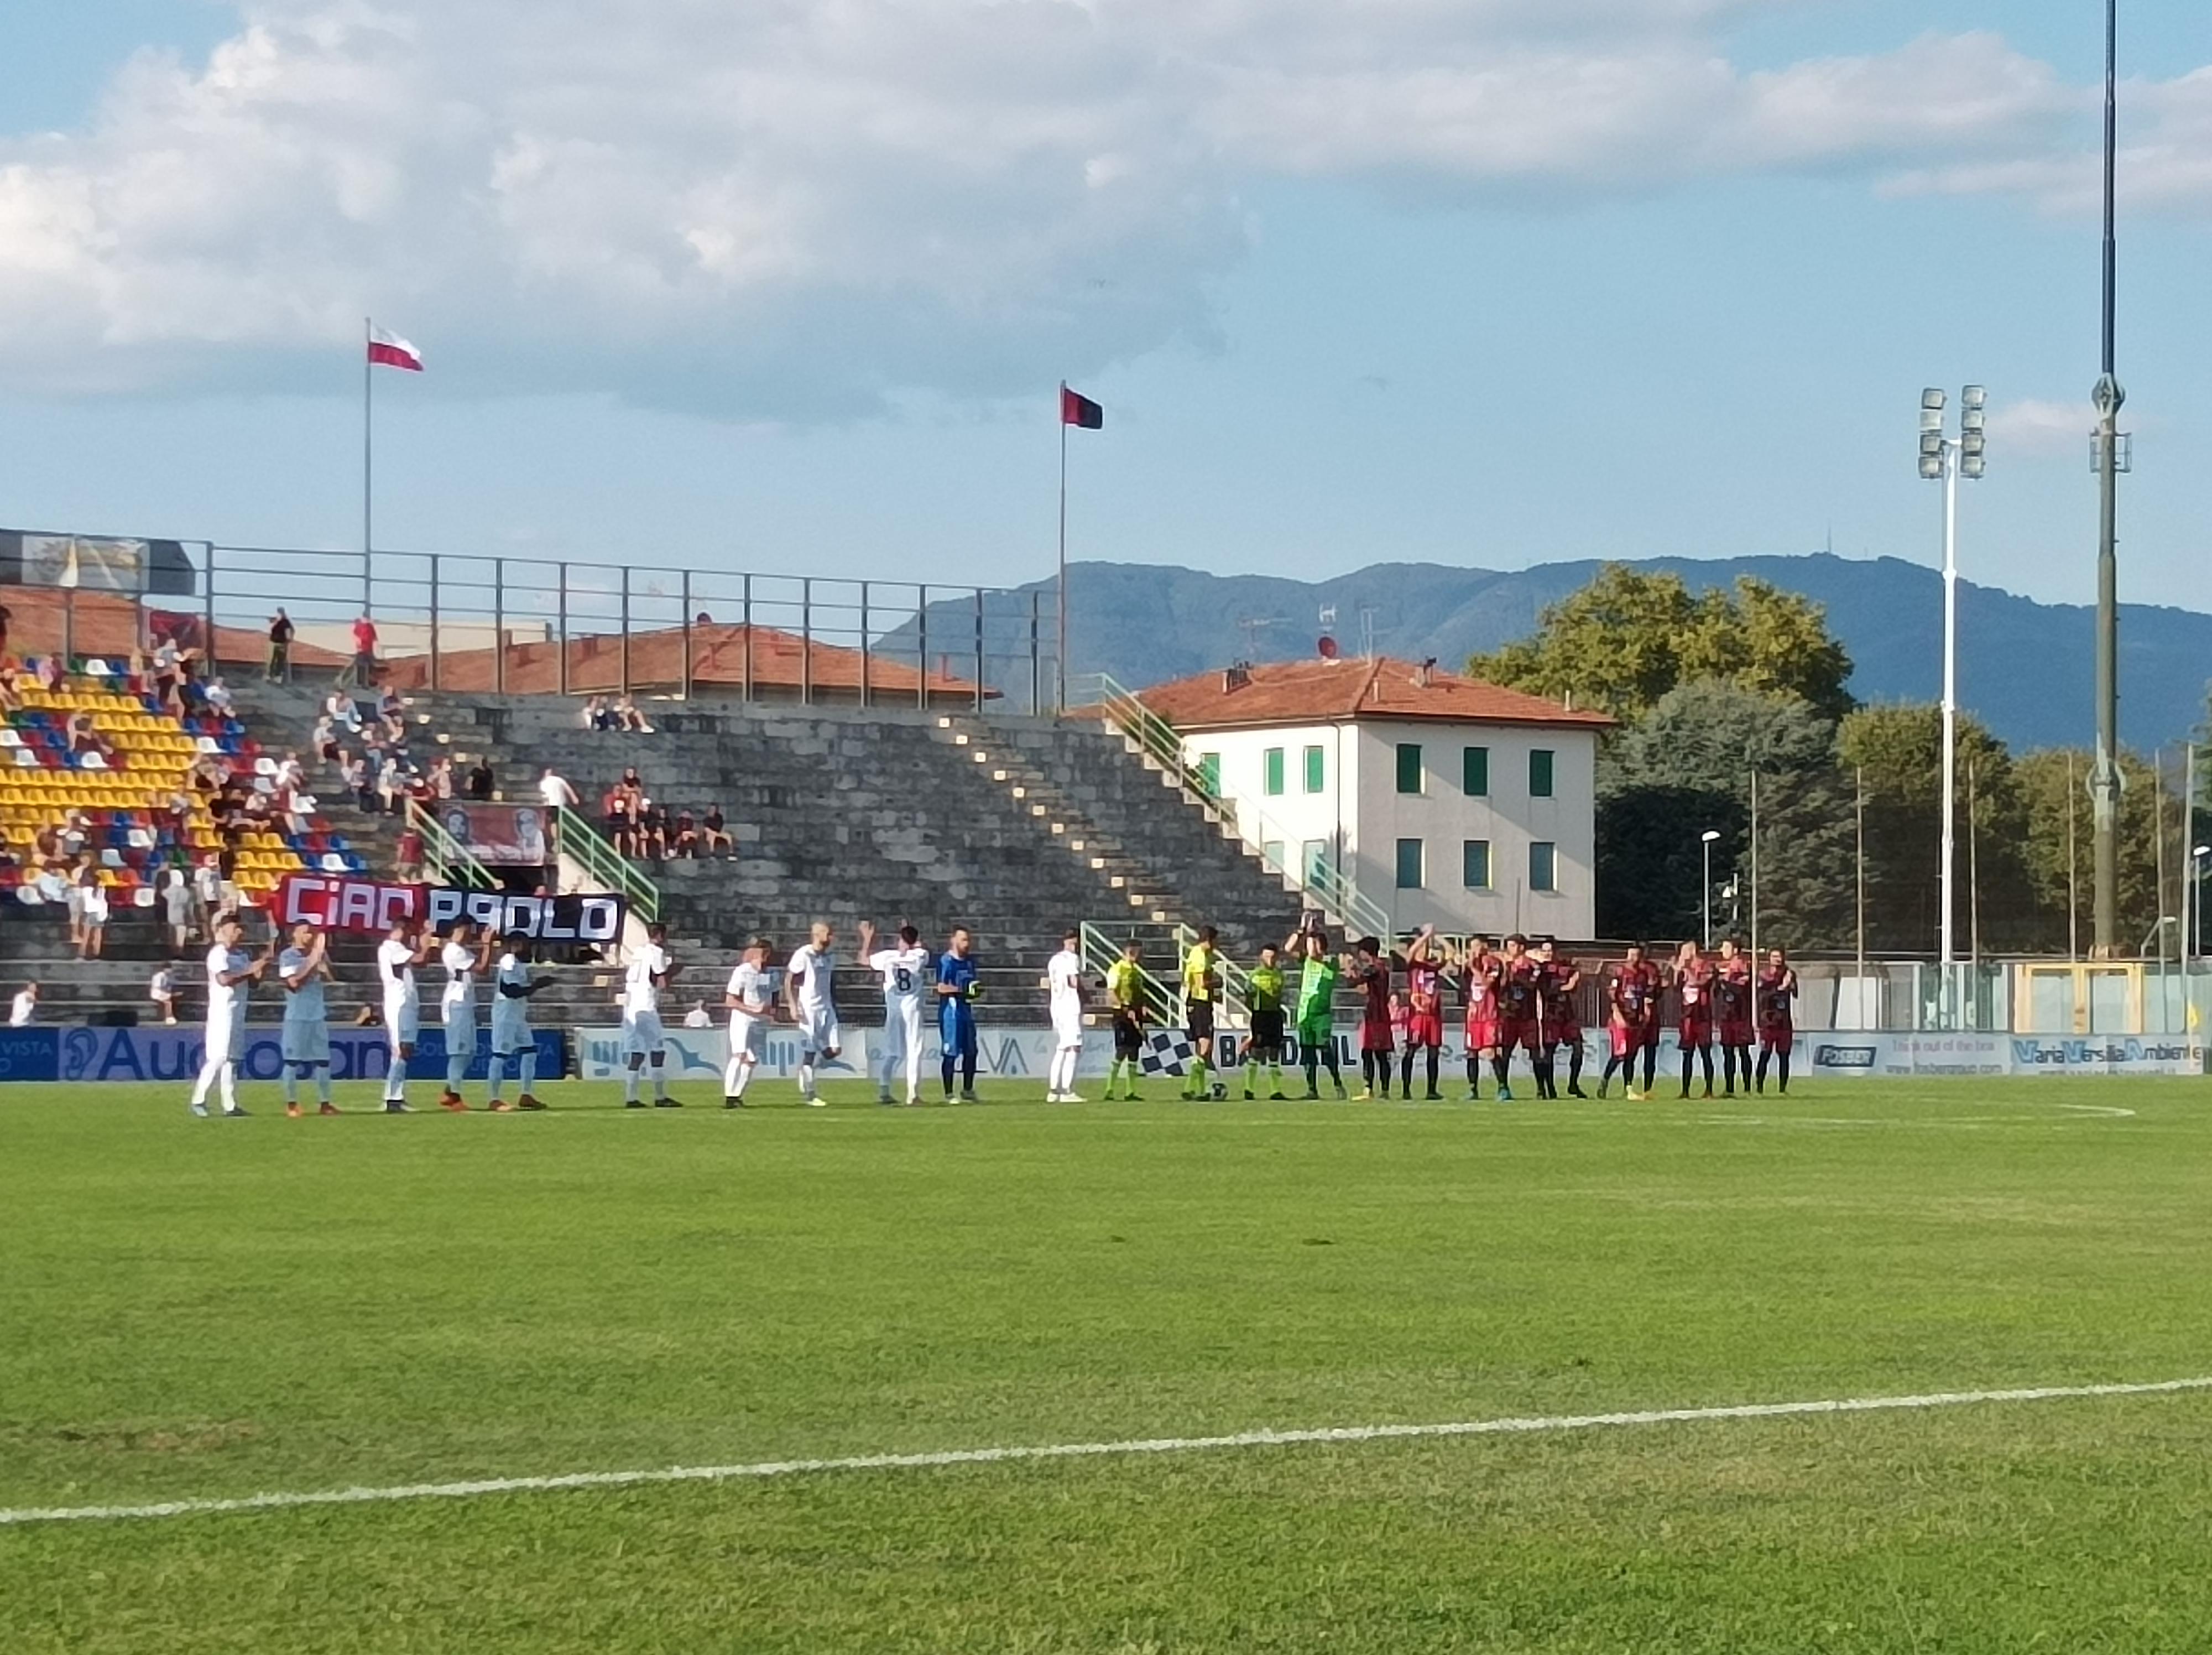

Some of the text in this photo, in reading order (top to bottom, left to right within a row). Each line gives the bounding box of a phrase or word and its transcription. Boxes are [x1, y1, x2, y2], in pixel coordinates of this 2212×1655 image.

[898, 969, 911, 991] 8
[1, 1040, 53, 1057] VISTA
[97, 1028, 392, 1080] Auoan
